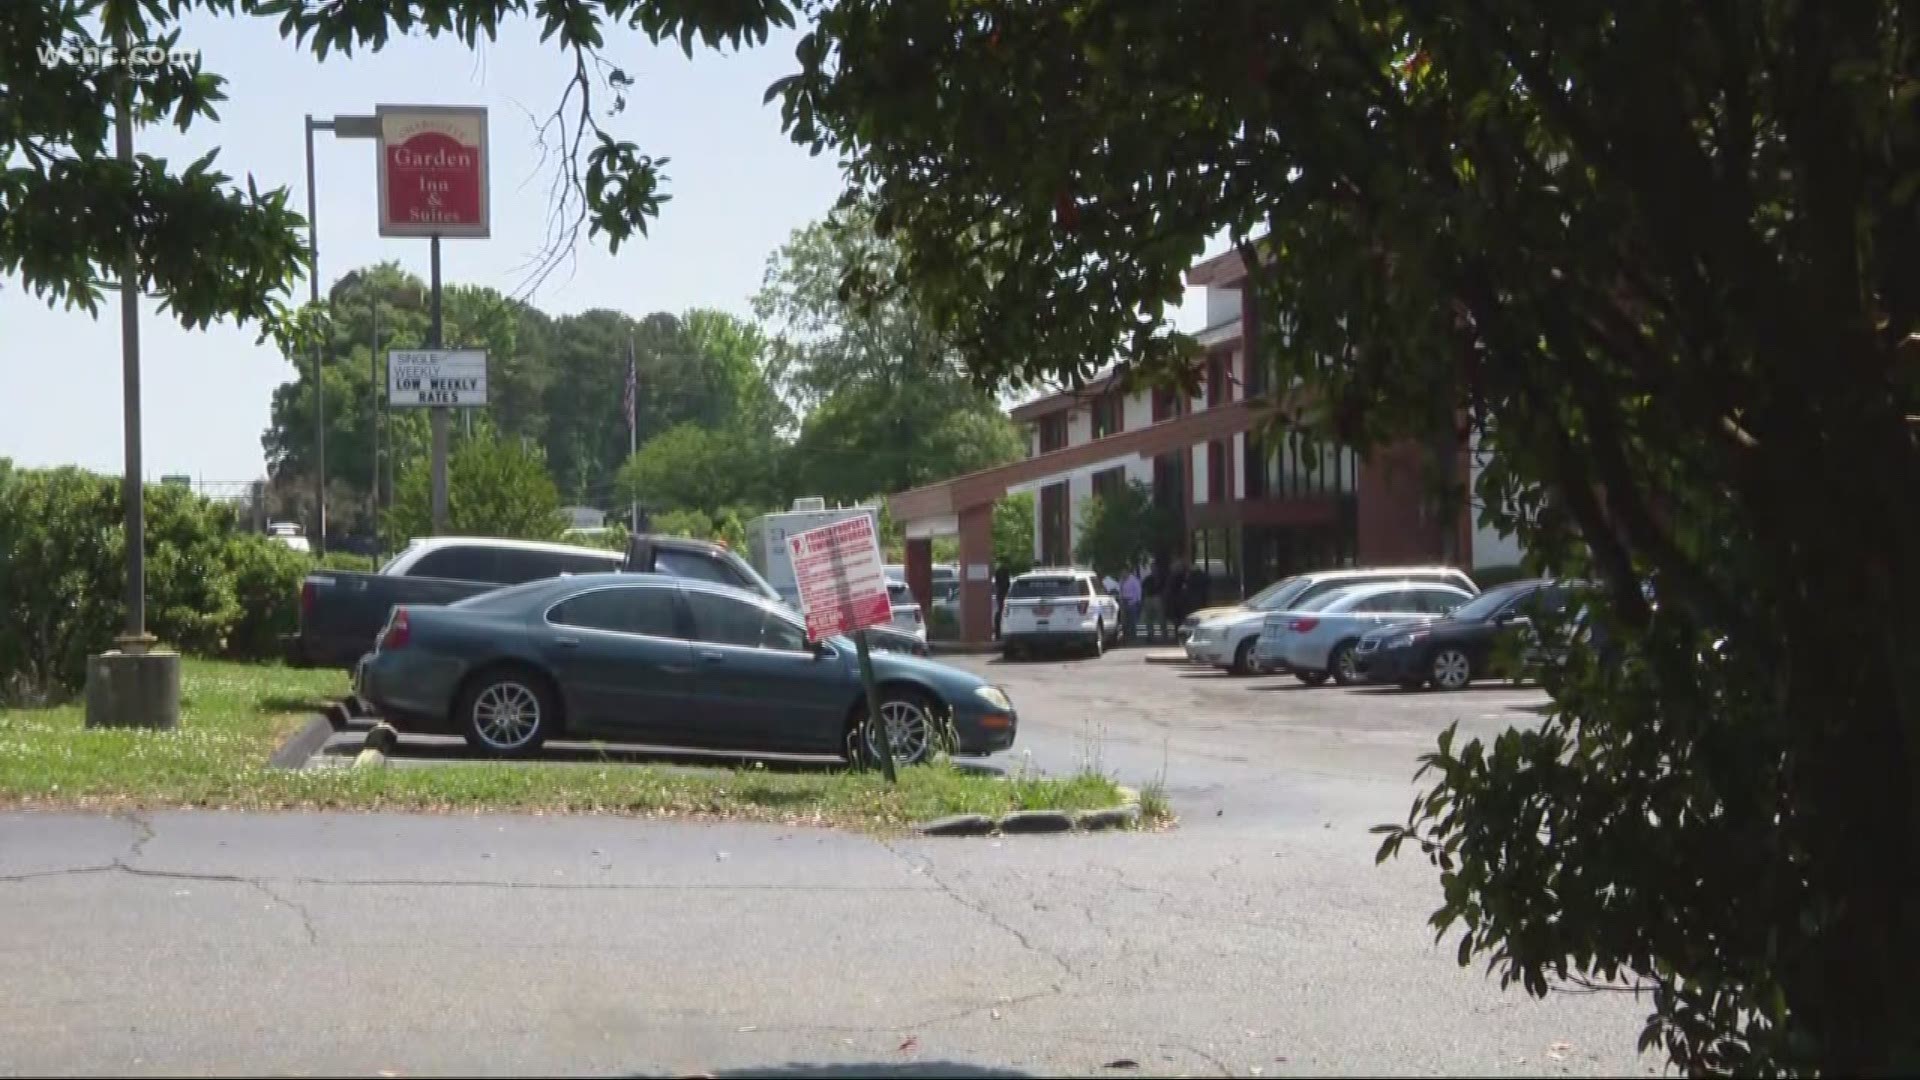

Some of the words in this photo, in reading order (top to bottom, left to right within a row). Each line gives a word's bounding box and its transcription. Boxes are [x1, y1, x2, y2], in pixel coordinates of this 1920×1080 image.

[394, 148, 471, 166] Garden
[419, 175, 449, 191] Inn
[428, 192, 443, 205] &
[410, 206, 460, 222] Suites
[397, 353, 440, 364] SINGLE
[395, 365, 440, 377] WEEKLY
[396, 378, 421, 390] LOW
[430, 377, 477, 390] WEEKLY
[419, 390, 459, 403] RATES
[834, 516, 868, 535] PROPERTY
[836, 527, 872, 542] ENFORCED
